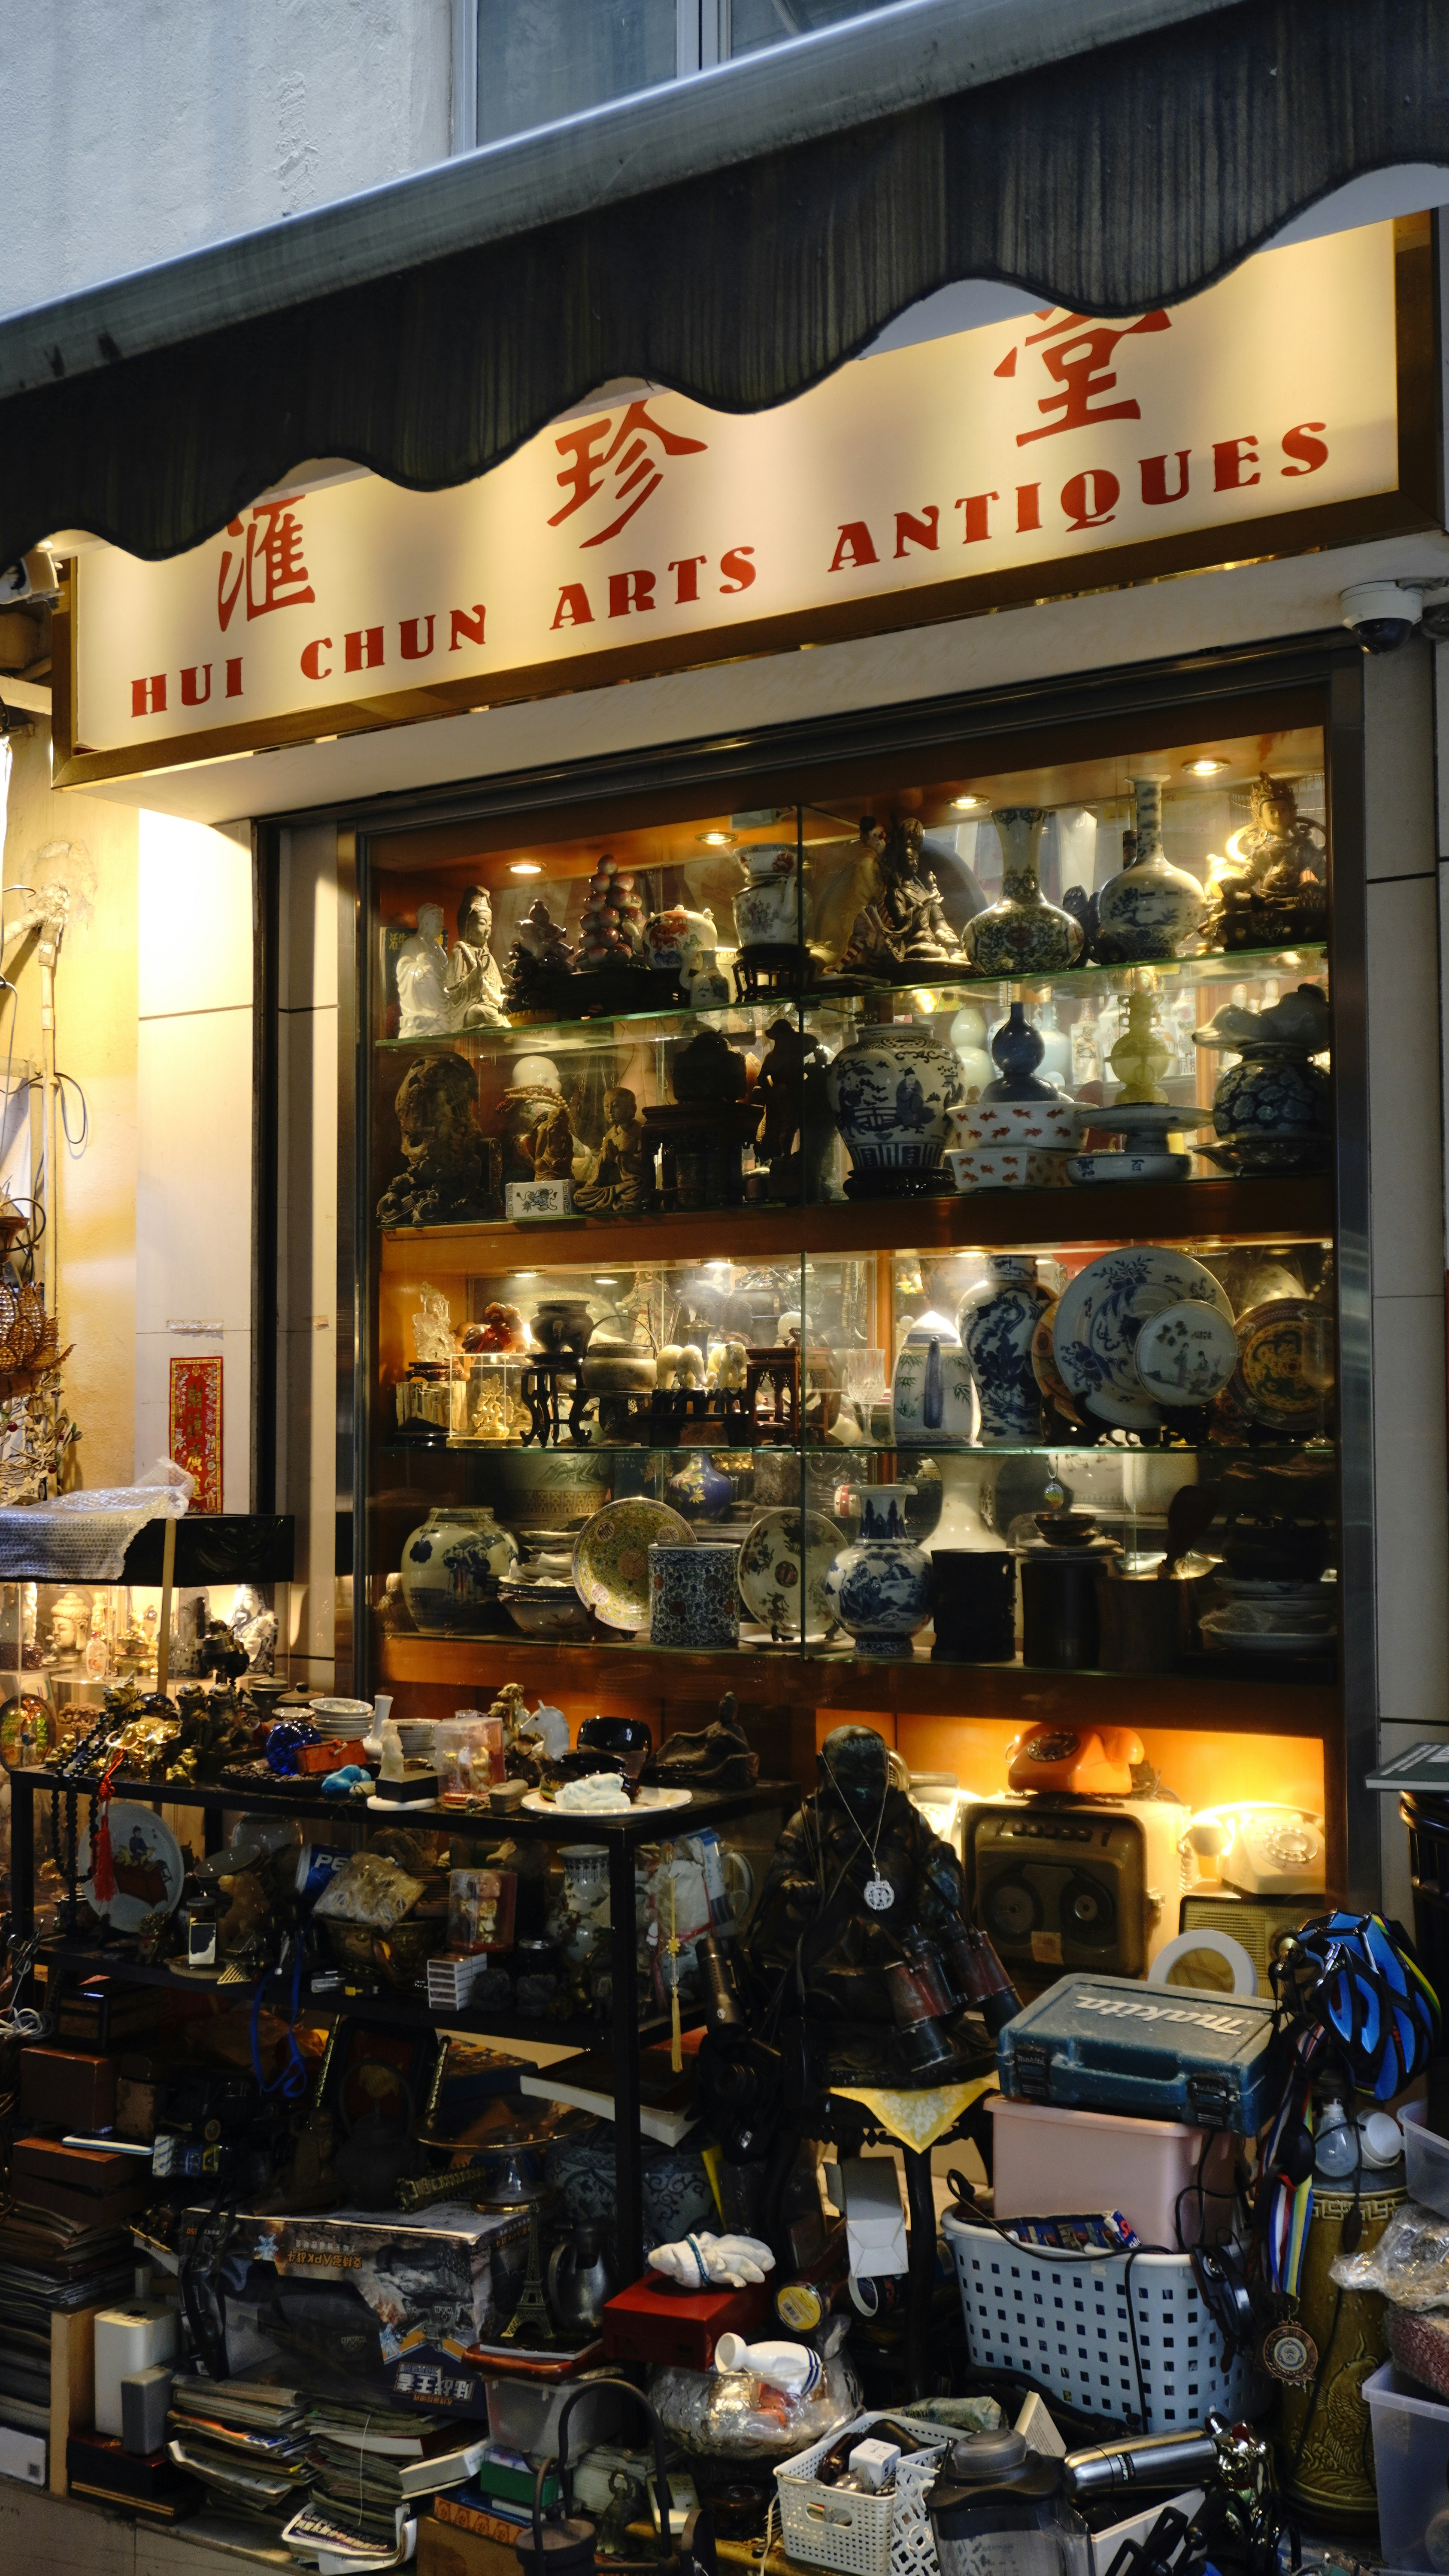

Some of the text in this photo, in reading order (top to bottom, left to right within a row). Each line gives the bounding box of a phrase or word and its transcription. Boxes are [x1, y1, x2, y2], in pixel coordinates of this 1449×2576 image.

[131, 422, 1328, 717] HUI CHUN ARTS ANTIQUES
